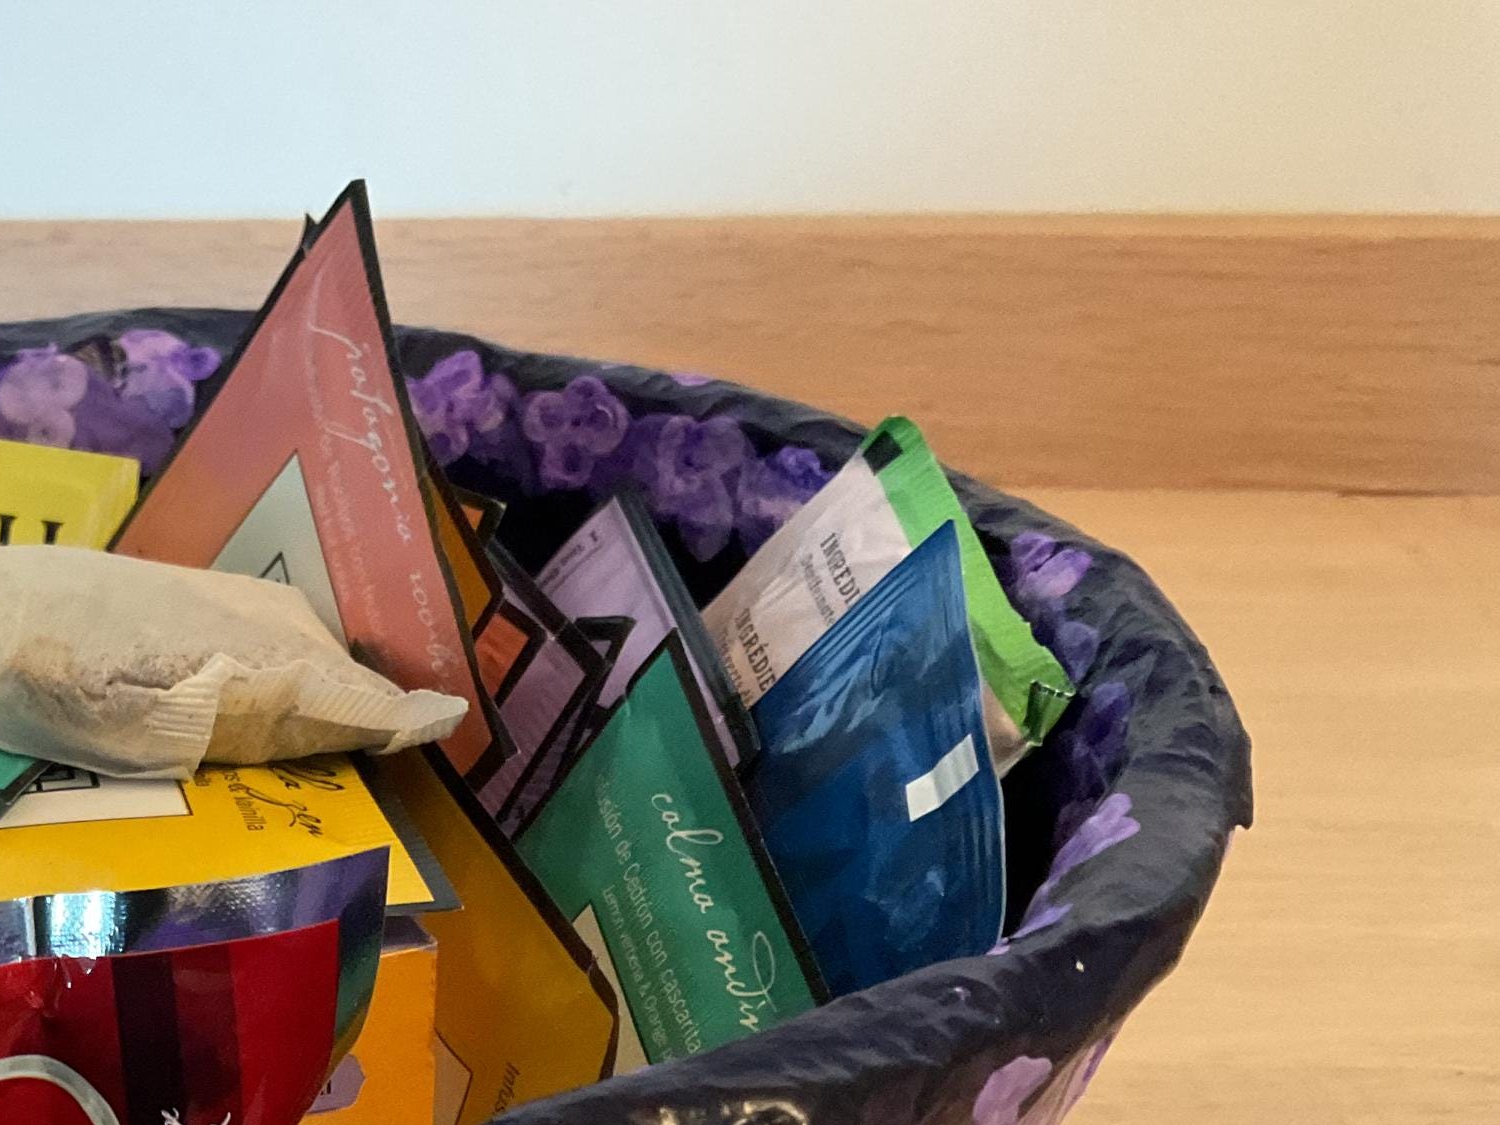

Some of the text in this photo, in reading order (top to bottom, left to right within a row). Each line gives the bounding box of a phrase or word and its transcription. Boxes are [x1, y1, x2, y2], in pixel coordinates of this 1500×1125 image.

[820, 532, 861, 604] INGREDI
[734, 607, 777, 691] INGRÉDIE
[615, 838, 632, 866] de
[651, 793, 725, 914] calma
[622, 861, 654, 931] Cedrón
[645, 930, 669, 966] con
